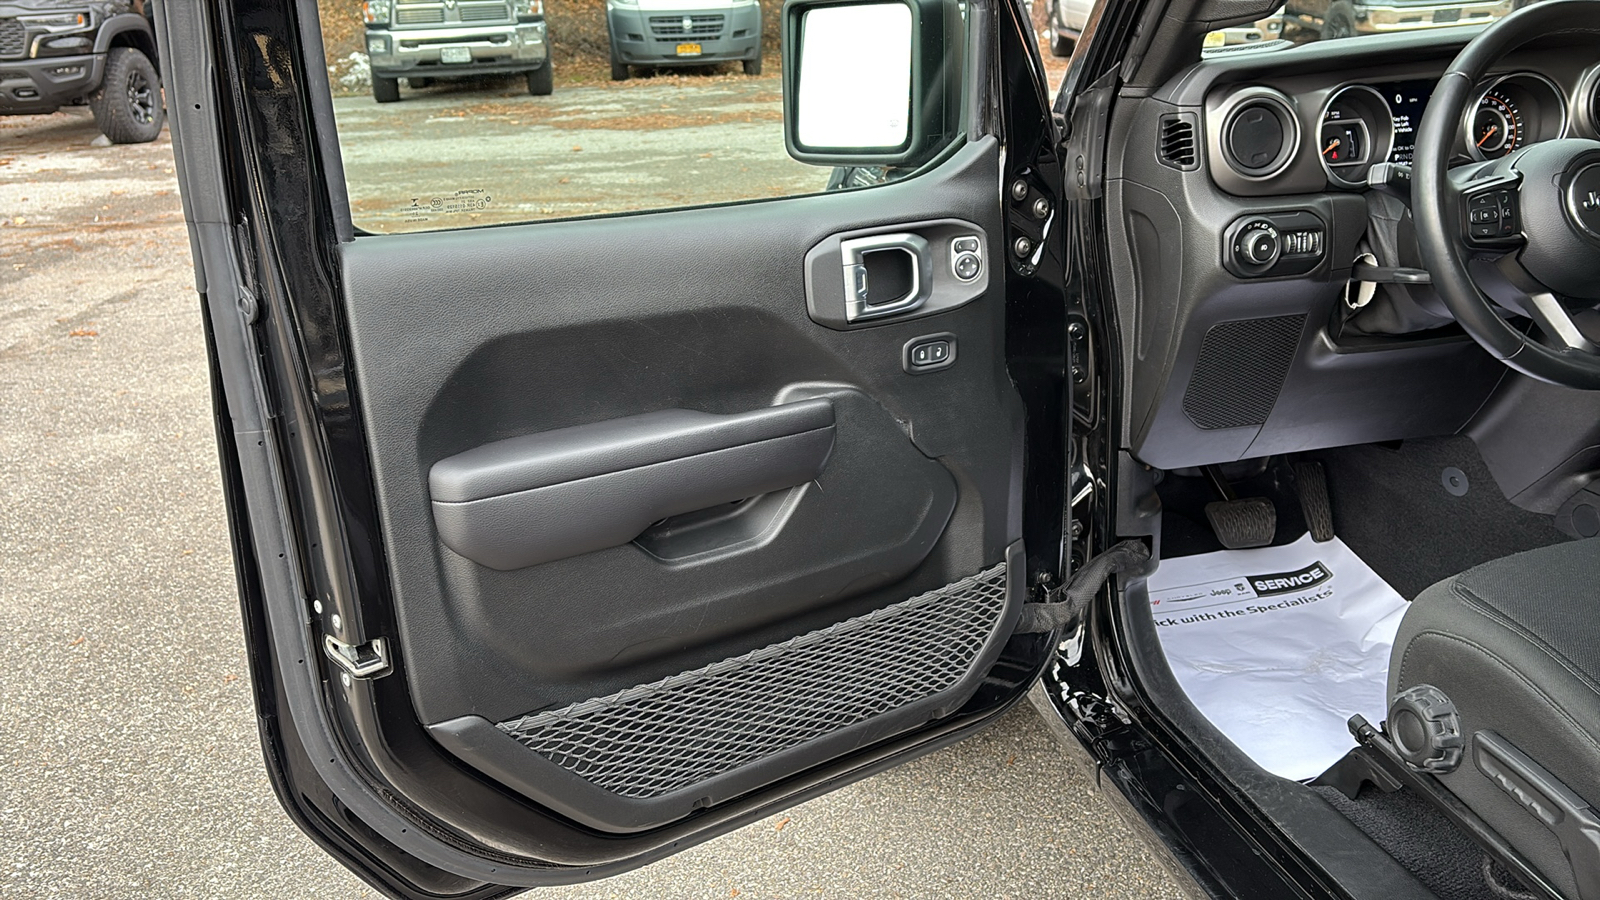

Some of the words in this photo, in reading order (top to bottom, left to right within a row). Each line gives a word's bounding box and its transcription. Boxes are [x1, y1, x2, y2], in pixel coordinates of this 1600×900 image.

[1395, 93, 1403, 104] 0
[1210, 588, 1232, 597] Jeep
[1255, 568, 1325, 591] SERVICE
[1154, 618, 1179, 627] ick
[1180, 613, 1217, 624] with
[1217, 609, 1246, 619] the
[1245, 589, 1333, 616] Specialists
